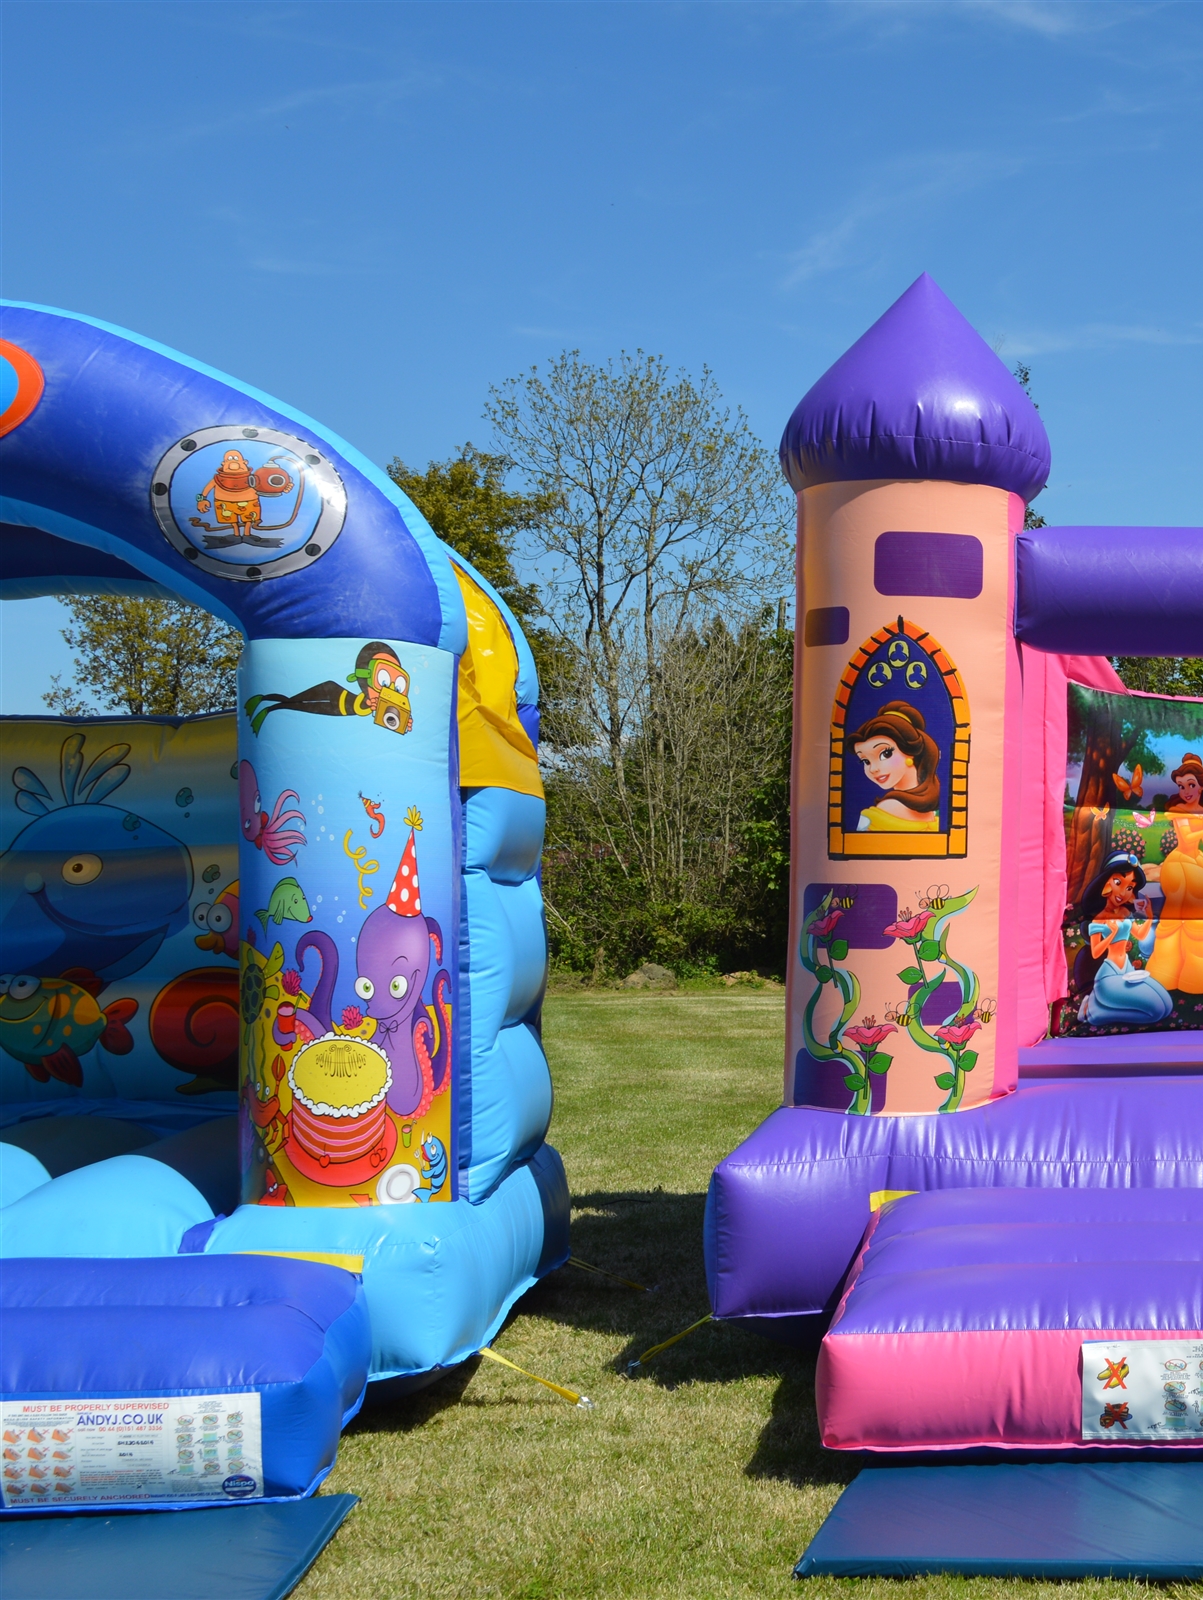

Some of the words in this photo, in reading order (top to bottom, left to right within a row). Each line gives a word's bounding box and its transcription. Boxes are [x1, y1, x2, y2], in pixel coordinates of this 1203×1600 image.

[23, 1405, 47, 1413] MUST
[50, 1404, 62, 1412] BE
[64, 1403, 111, 1411] PROPERLY
[113, 1402, 170, 1411] SUPERVISED
[77, 1413, 163, 1425] ANDYJ.CO.UK
